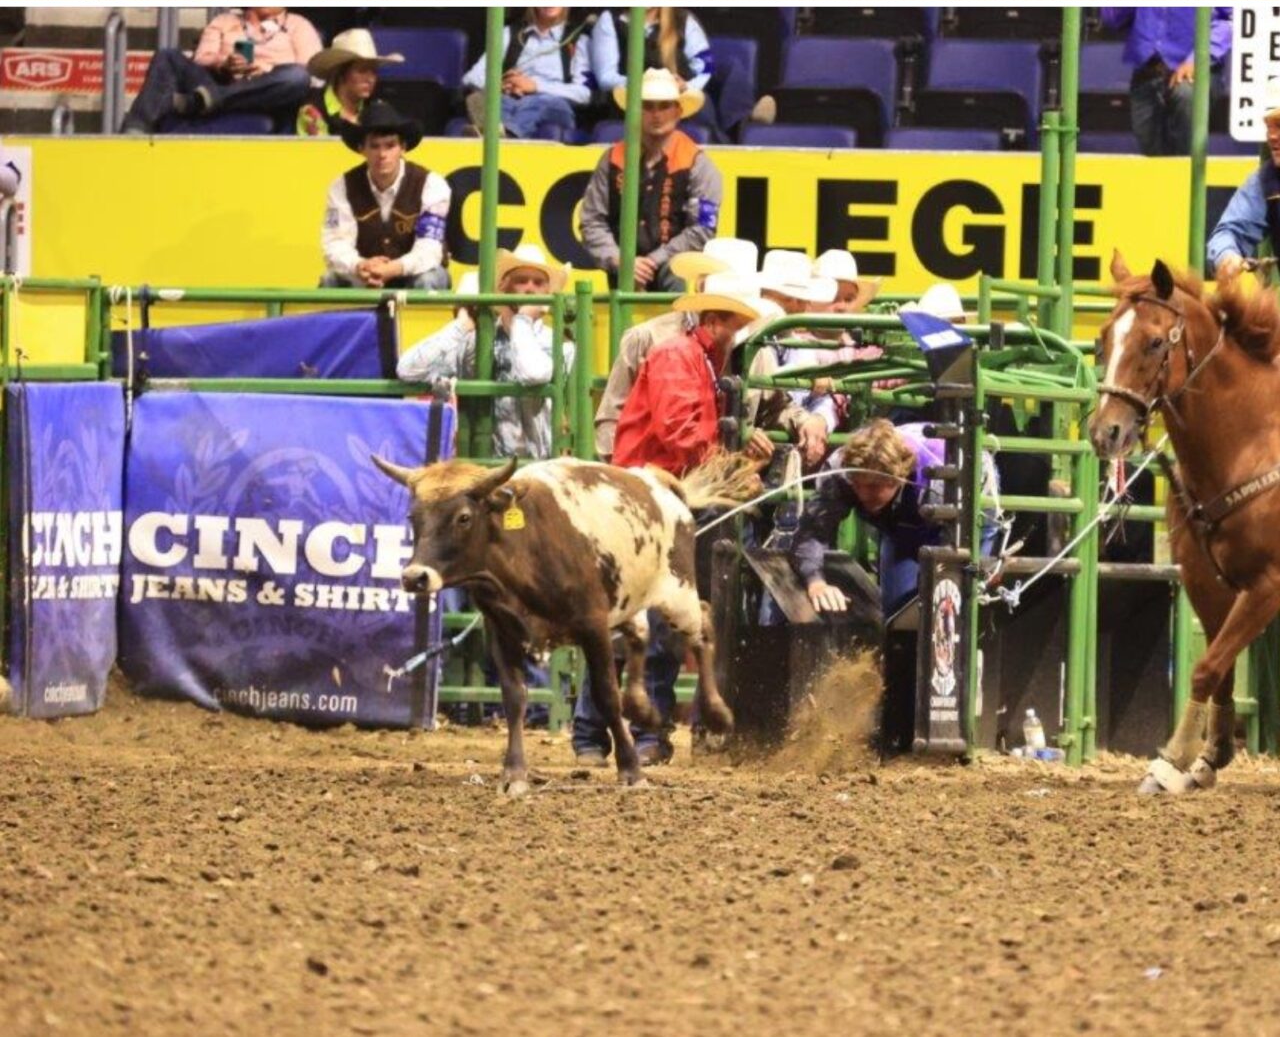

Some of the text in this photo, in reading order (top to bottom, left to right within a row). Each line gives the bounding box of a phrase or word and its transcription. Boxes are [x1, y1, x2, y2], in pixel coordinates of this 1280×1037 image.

[15, 61, 62, 77] ARS
[446, 166, 1103, 279] CLEGE
[130, 575, 247, 604] JEANS
[256, 581, 285, 606] &
[212, 685, 358, 713] cinchjeans.com
